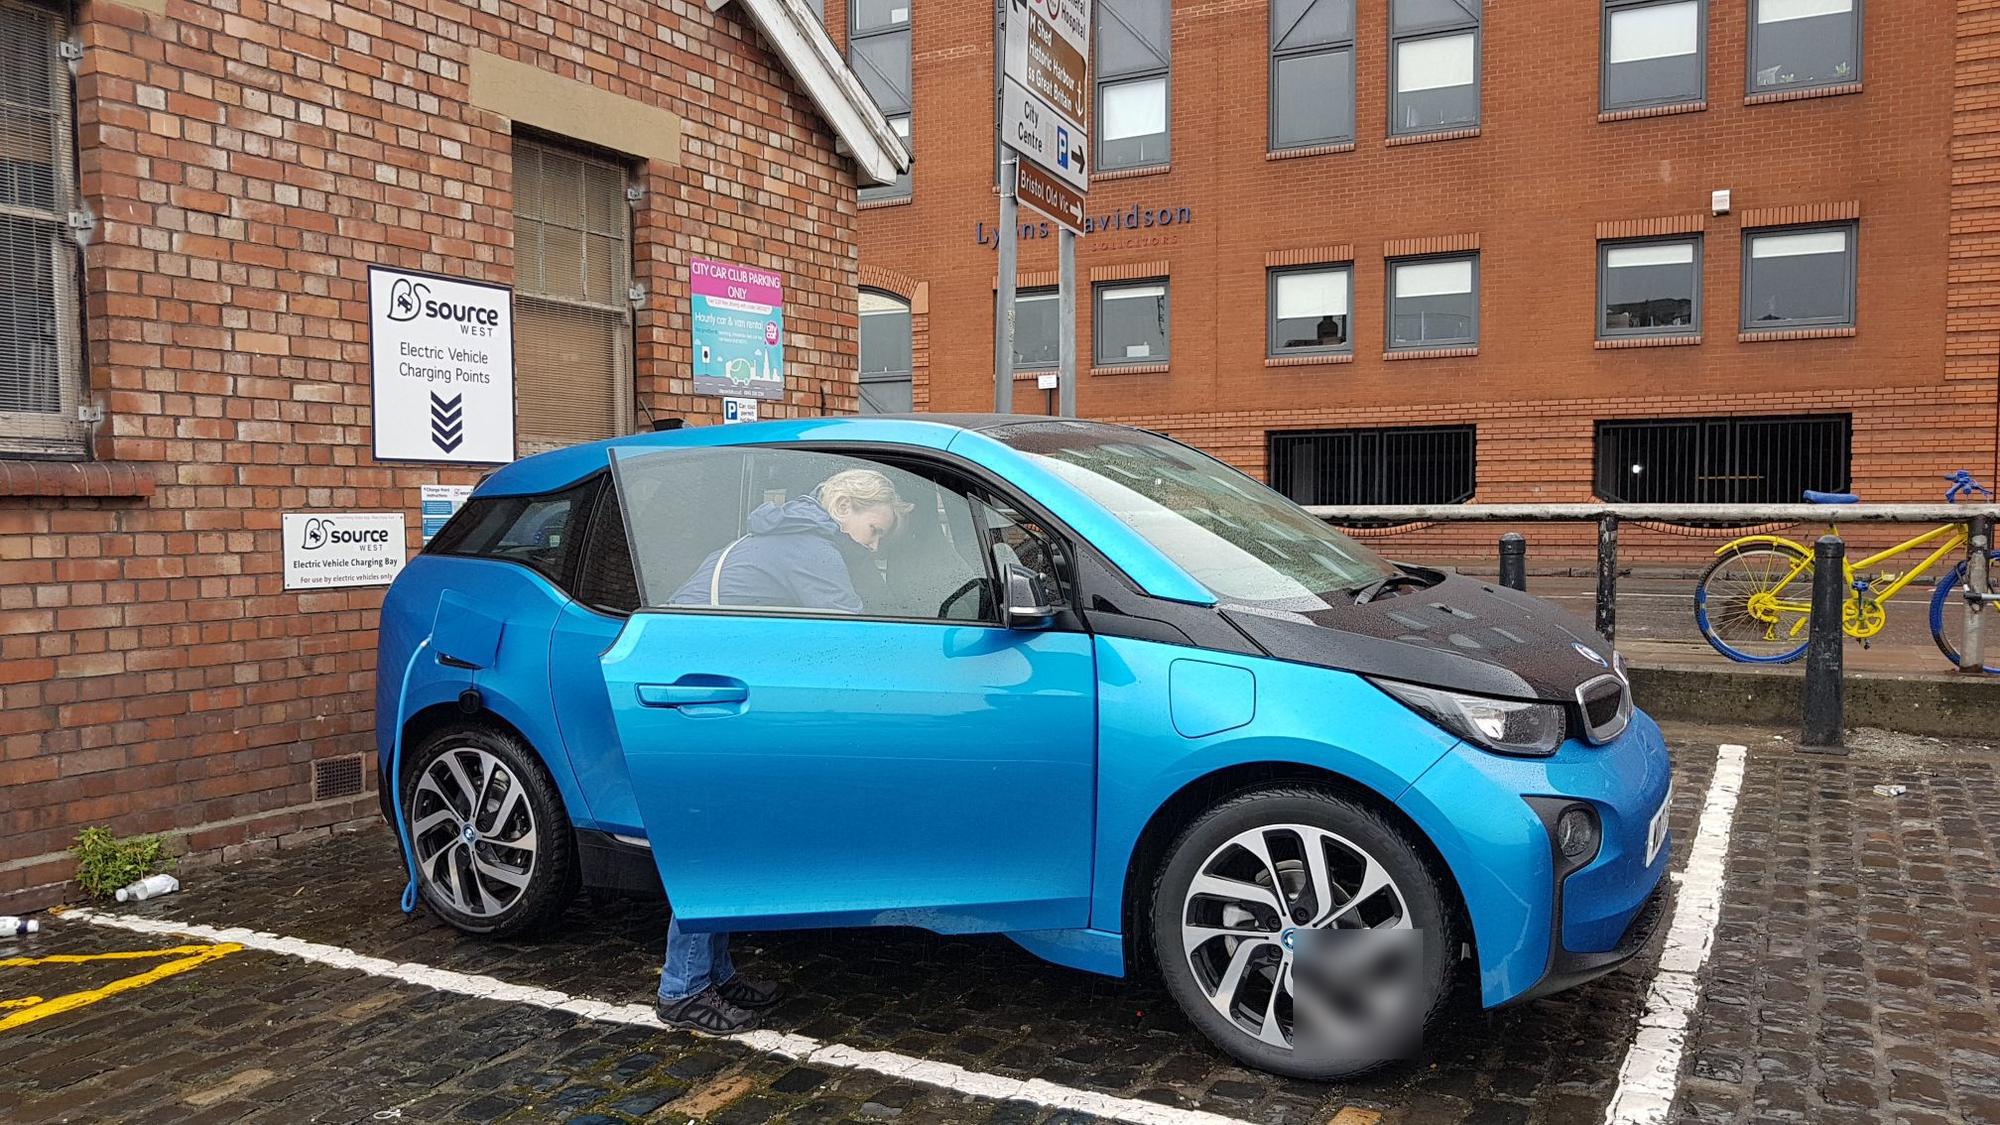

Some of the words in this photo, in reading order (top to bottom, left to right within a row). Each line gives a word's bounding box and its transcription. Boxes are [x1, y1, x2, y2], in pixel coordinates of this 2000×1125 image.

[1029, 12, 1036, 33] M
[1037, 19, 1052, 47] Shed
[1061, 2, 1085, 40] Hospital
[1029, 37, 1052, 72] Historic
[1053, 59, 1075, 91] Harbour
[1036, 70, 1053, 97] Great
[1053, 83, 1072, 111] Britain
[1024, 100, 1039, 129] City
[1018, 121, 1042, 153] Centre
[1021, 169, 1044, 200] Bristol
[1045, 185, 1058, 207] Old
[1059, 196, 1069, 213] Vic
[976, 220, 1049, 250] Lyns
[1085, 203, 1191, 234] avidson
[1092, 235, 1178, 252] SOLICITORS
[692, 261, 710, 276] CITY
[710, 265, 727, 280] CAR
[728, 268, 748, 283] CLUB
[749, 272, 780, 289] PARKING
[727, 285, 747, 300] ONLY
[425, 300, 499, 327] source
[695, 312, 715, 326] Hourly
[717, 316, 726, 325] car
[728, 316, 733, 326] &
[734, 319, 745, 328] van
[746, 319, 763, 330] rental
[460, 325, 493, 338] WEST
[400, 341, 444, 360] Electric
[448, 347, 489, 364] Vehicle
[399, 362, 451, 384] Charging
[455, 368, 490, 384] Points
[331, 529, 389, 544] source
[293, 560, 320, 569] Electric
[322, 558, 349, 568] Vehicle
[350, 558, 383, 568] Charging
[384, 557, 397, 567] Bay
[323, 575, 331, 583] by
[333, 574, 355, 582] electric
[356, 573, 379, 581] vehicles
[380, 573, 393, 582] only
